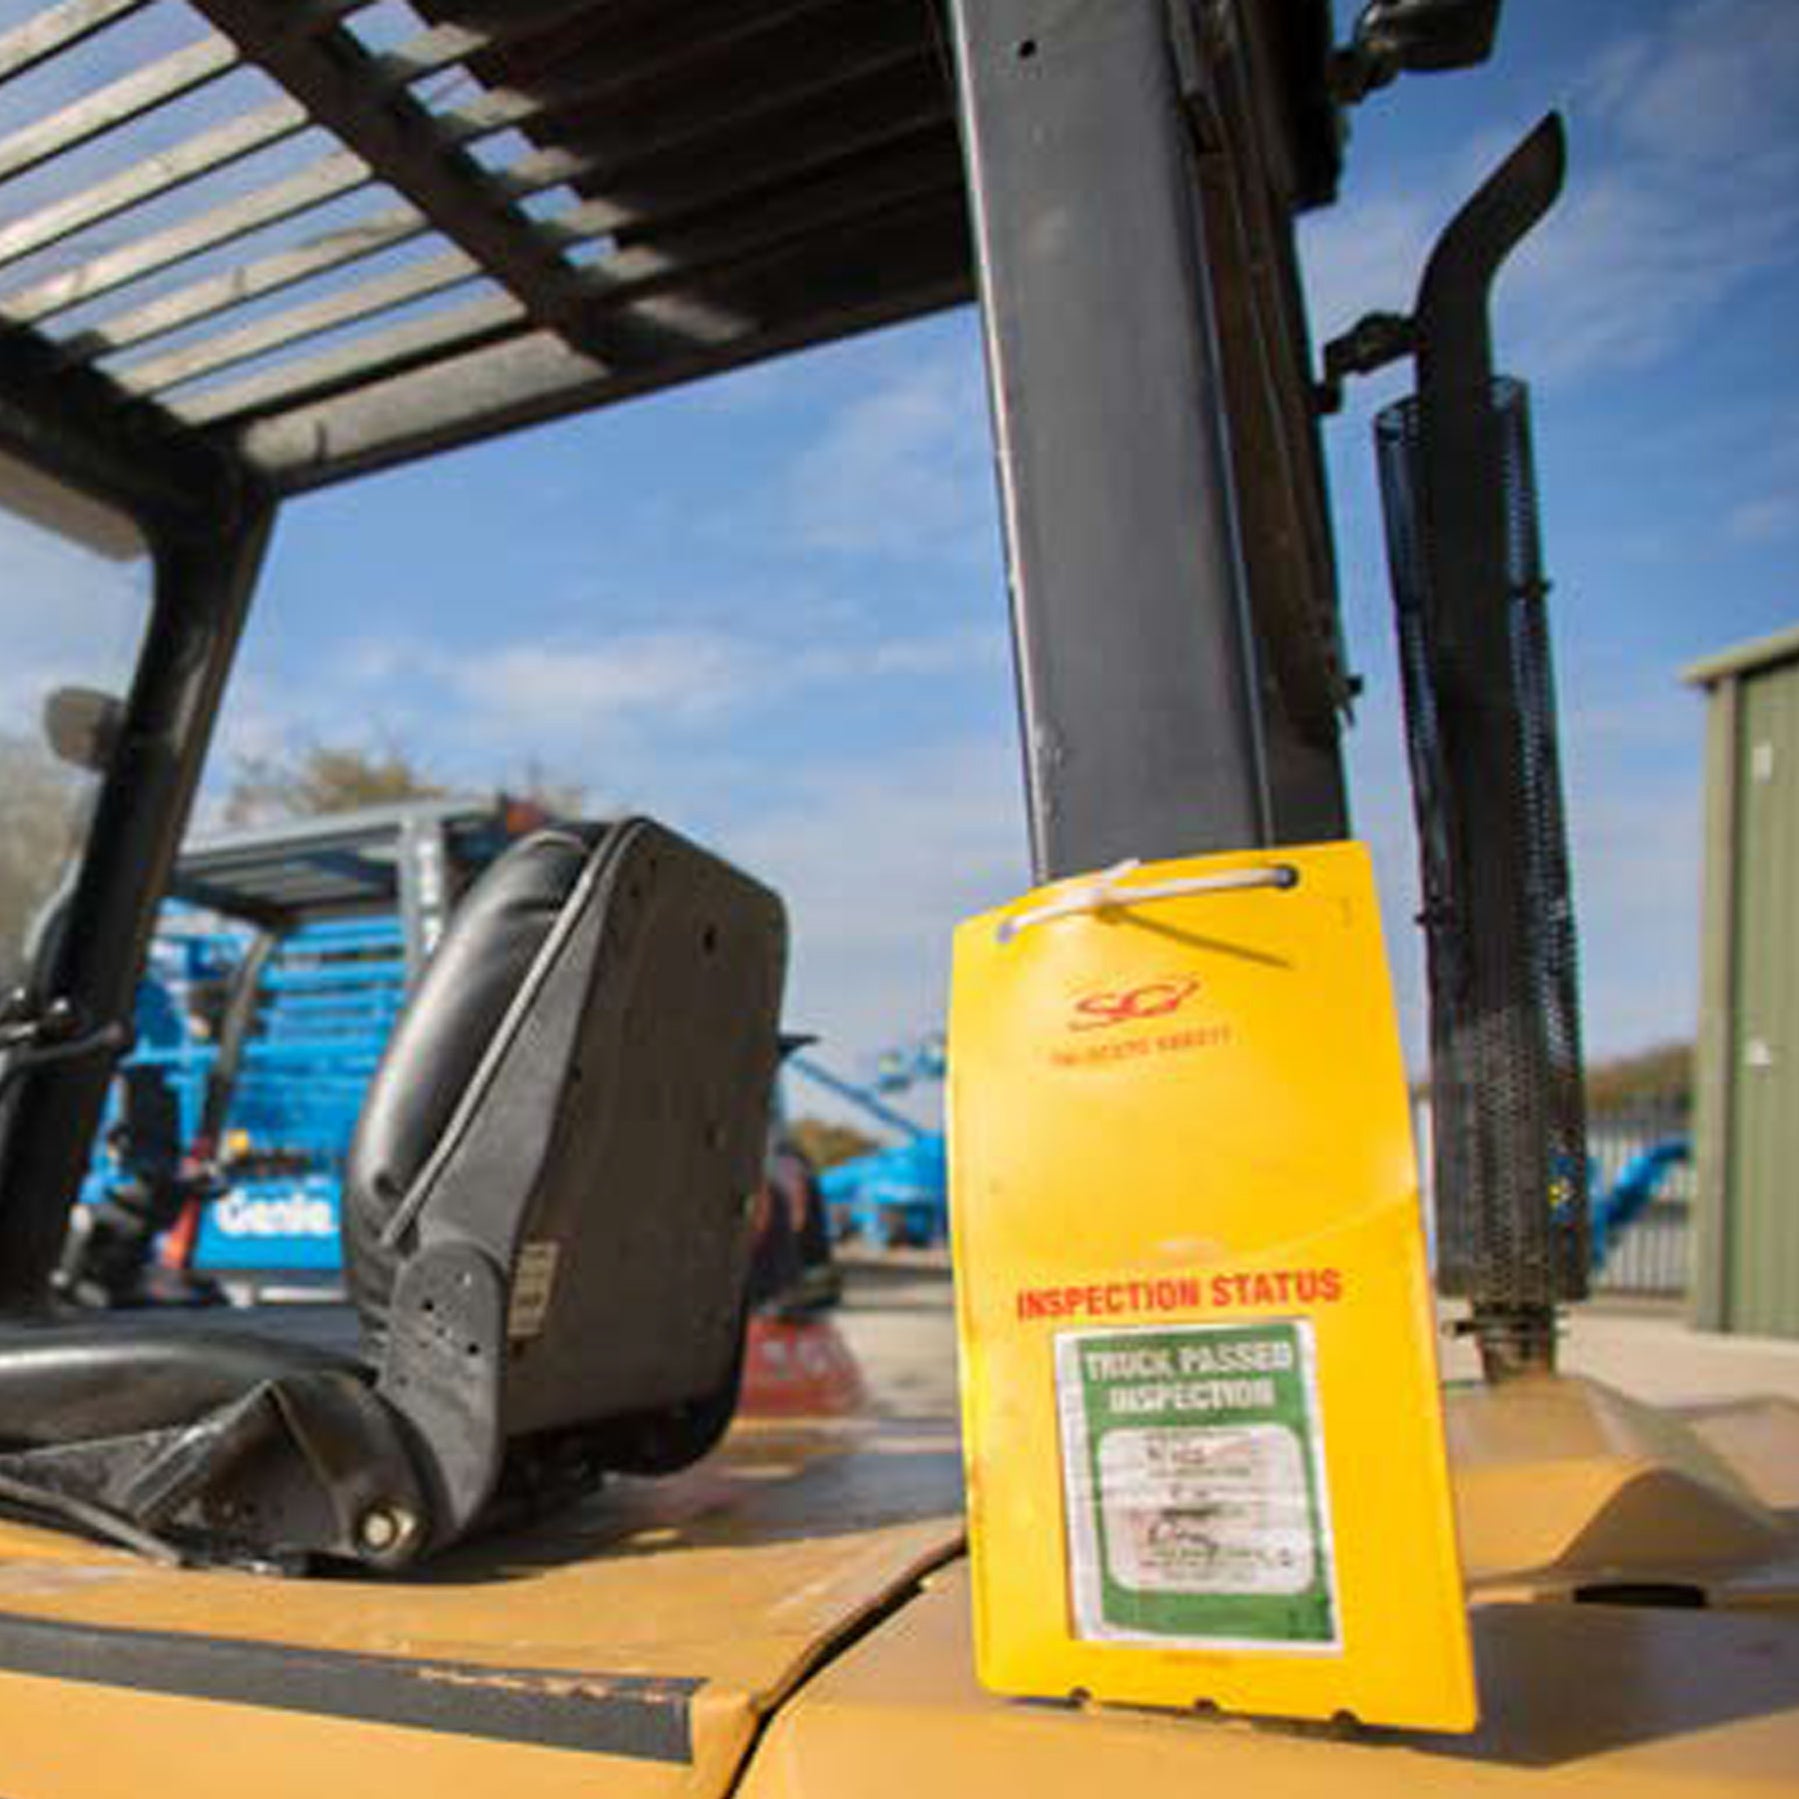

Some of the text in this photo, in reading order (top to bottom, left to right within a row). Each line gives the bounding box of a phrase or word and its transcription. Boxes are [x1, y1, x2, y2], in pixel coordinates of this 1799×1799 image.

[1017, 1268, 1342, 1320] INSPECTION STATUS
[1086, 1340, 1293, 1381] TRUCK PASSED
[1108, 1378, 1275, 1412] INSPECTION
